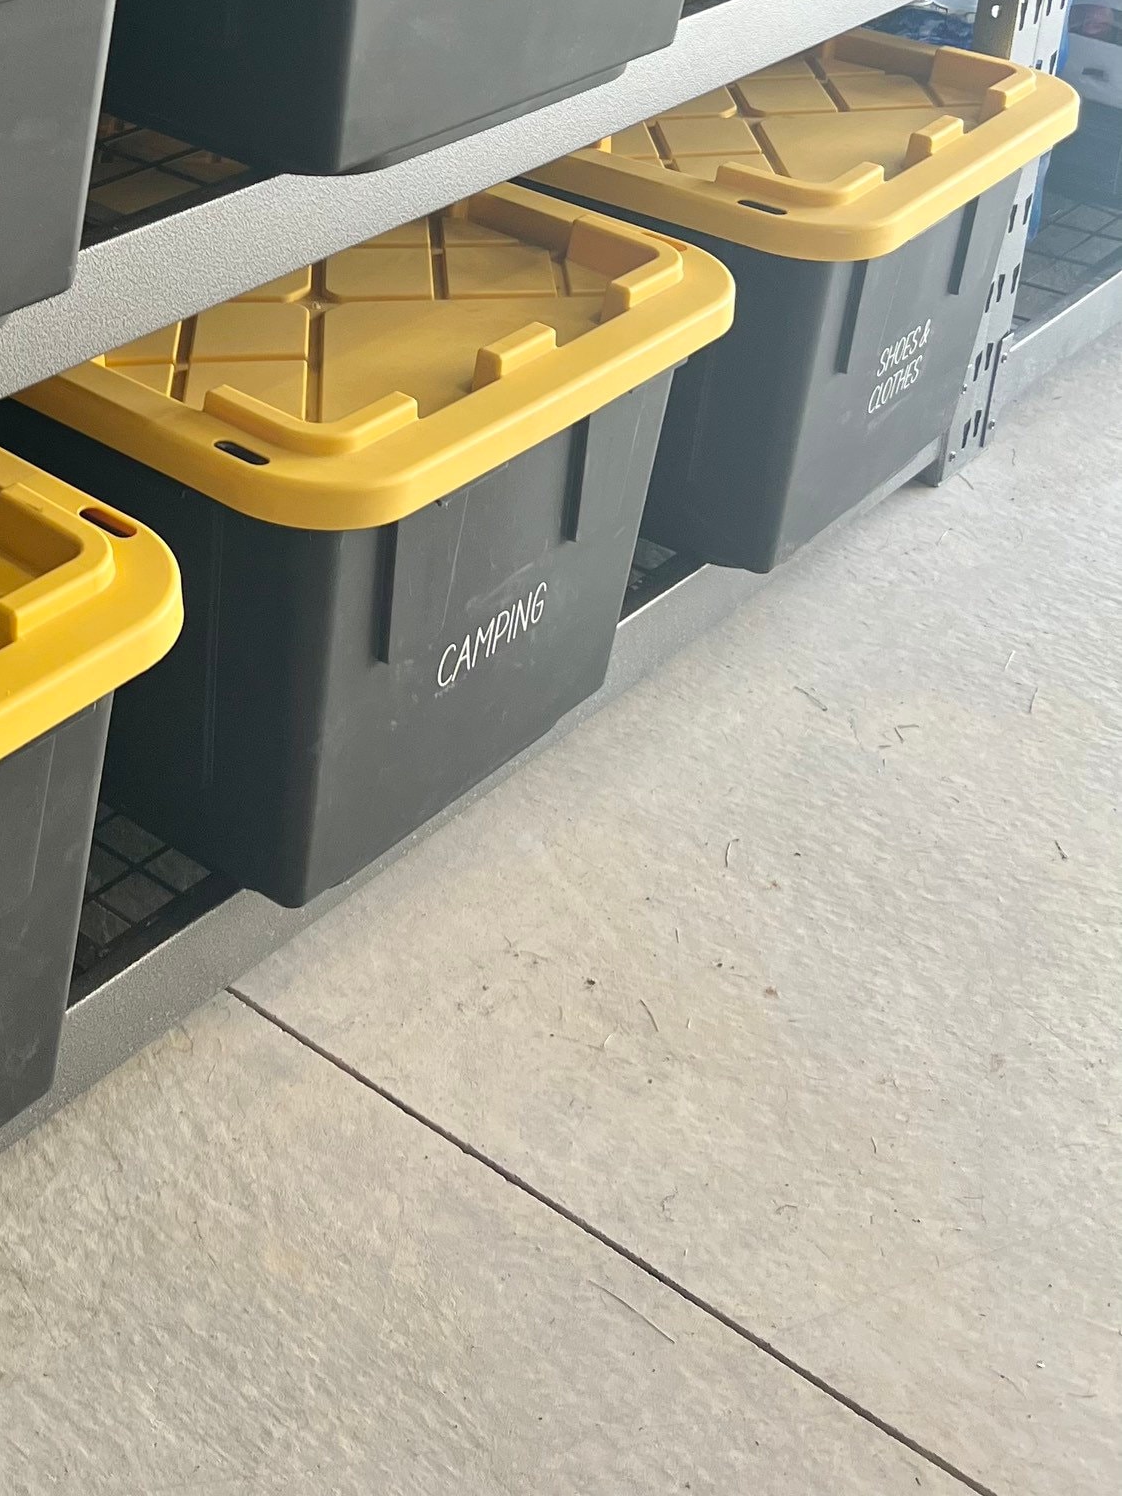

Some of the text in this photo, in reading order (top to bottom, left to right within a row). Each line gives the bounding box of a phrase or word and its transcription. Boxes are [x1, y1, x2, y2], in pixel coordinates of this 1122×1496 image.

[876, 325, 922, 377] SHOES
[867, 354, 923, 414] CLOTHES
[437, 581, 547, 688] CAMPING
